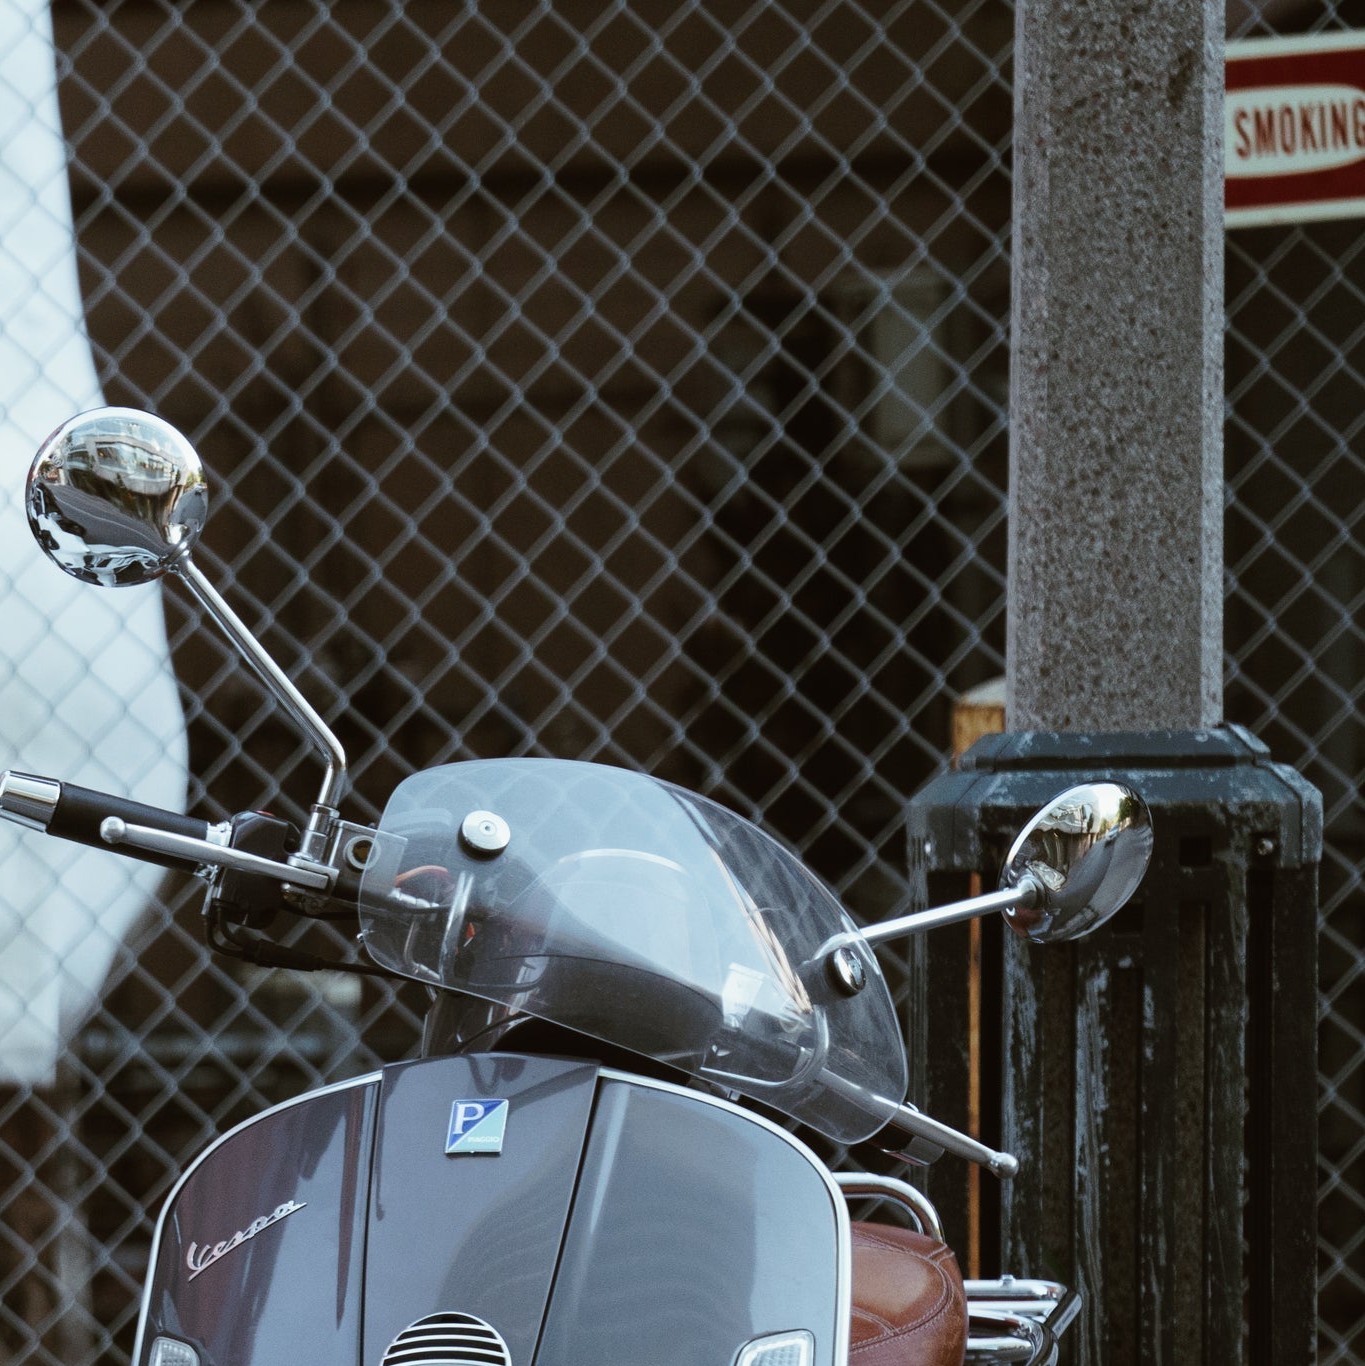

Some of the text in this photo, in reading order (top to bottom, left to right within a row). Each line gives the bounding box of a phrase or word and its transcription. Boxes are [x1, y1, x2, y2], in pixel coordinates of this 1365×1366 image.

[1234, 98, 1365, 160] SMOKING
[452, 1103, 485, 1135] P
[186, 1200, 307, 1281] Vespa
